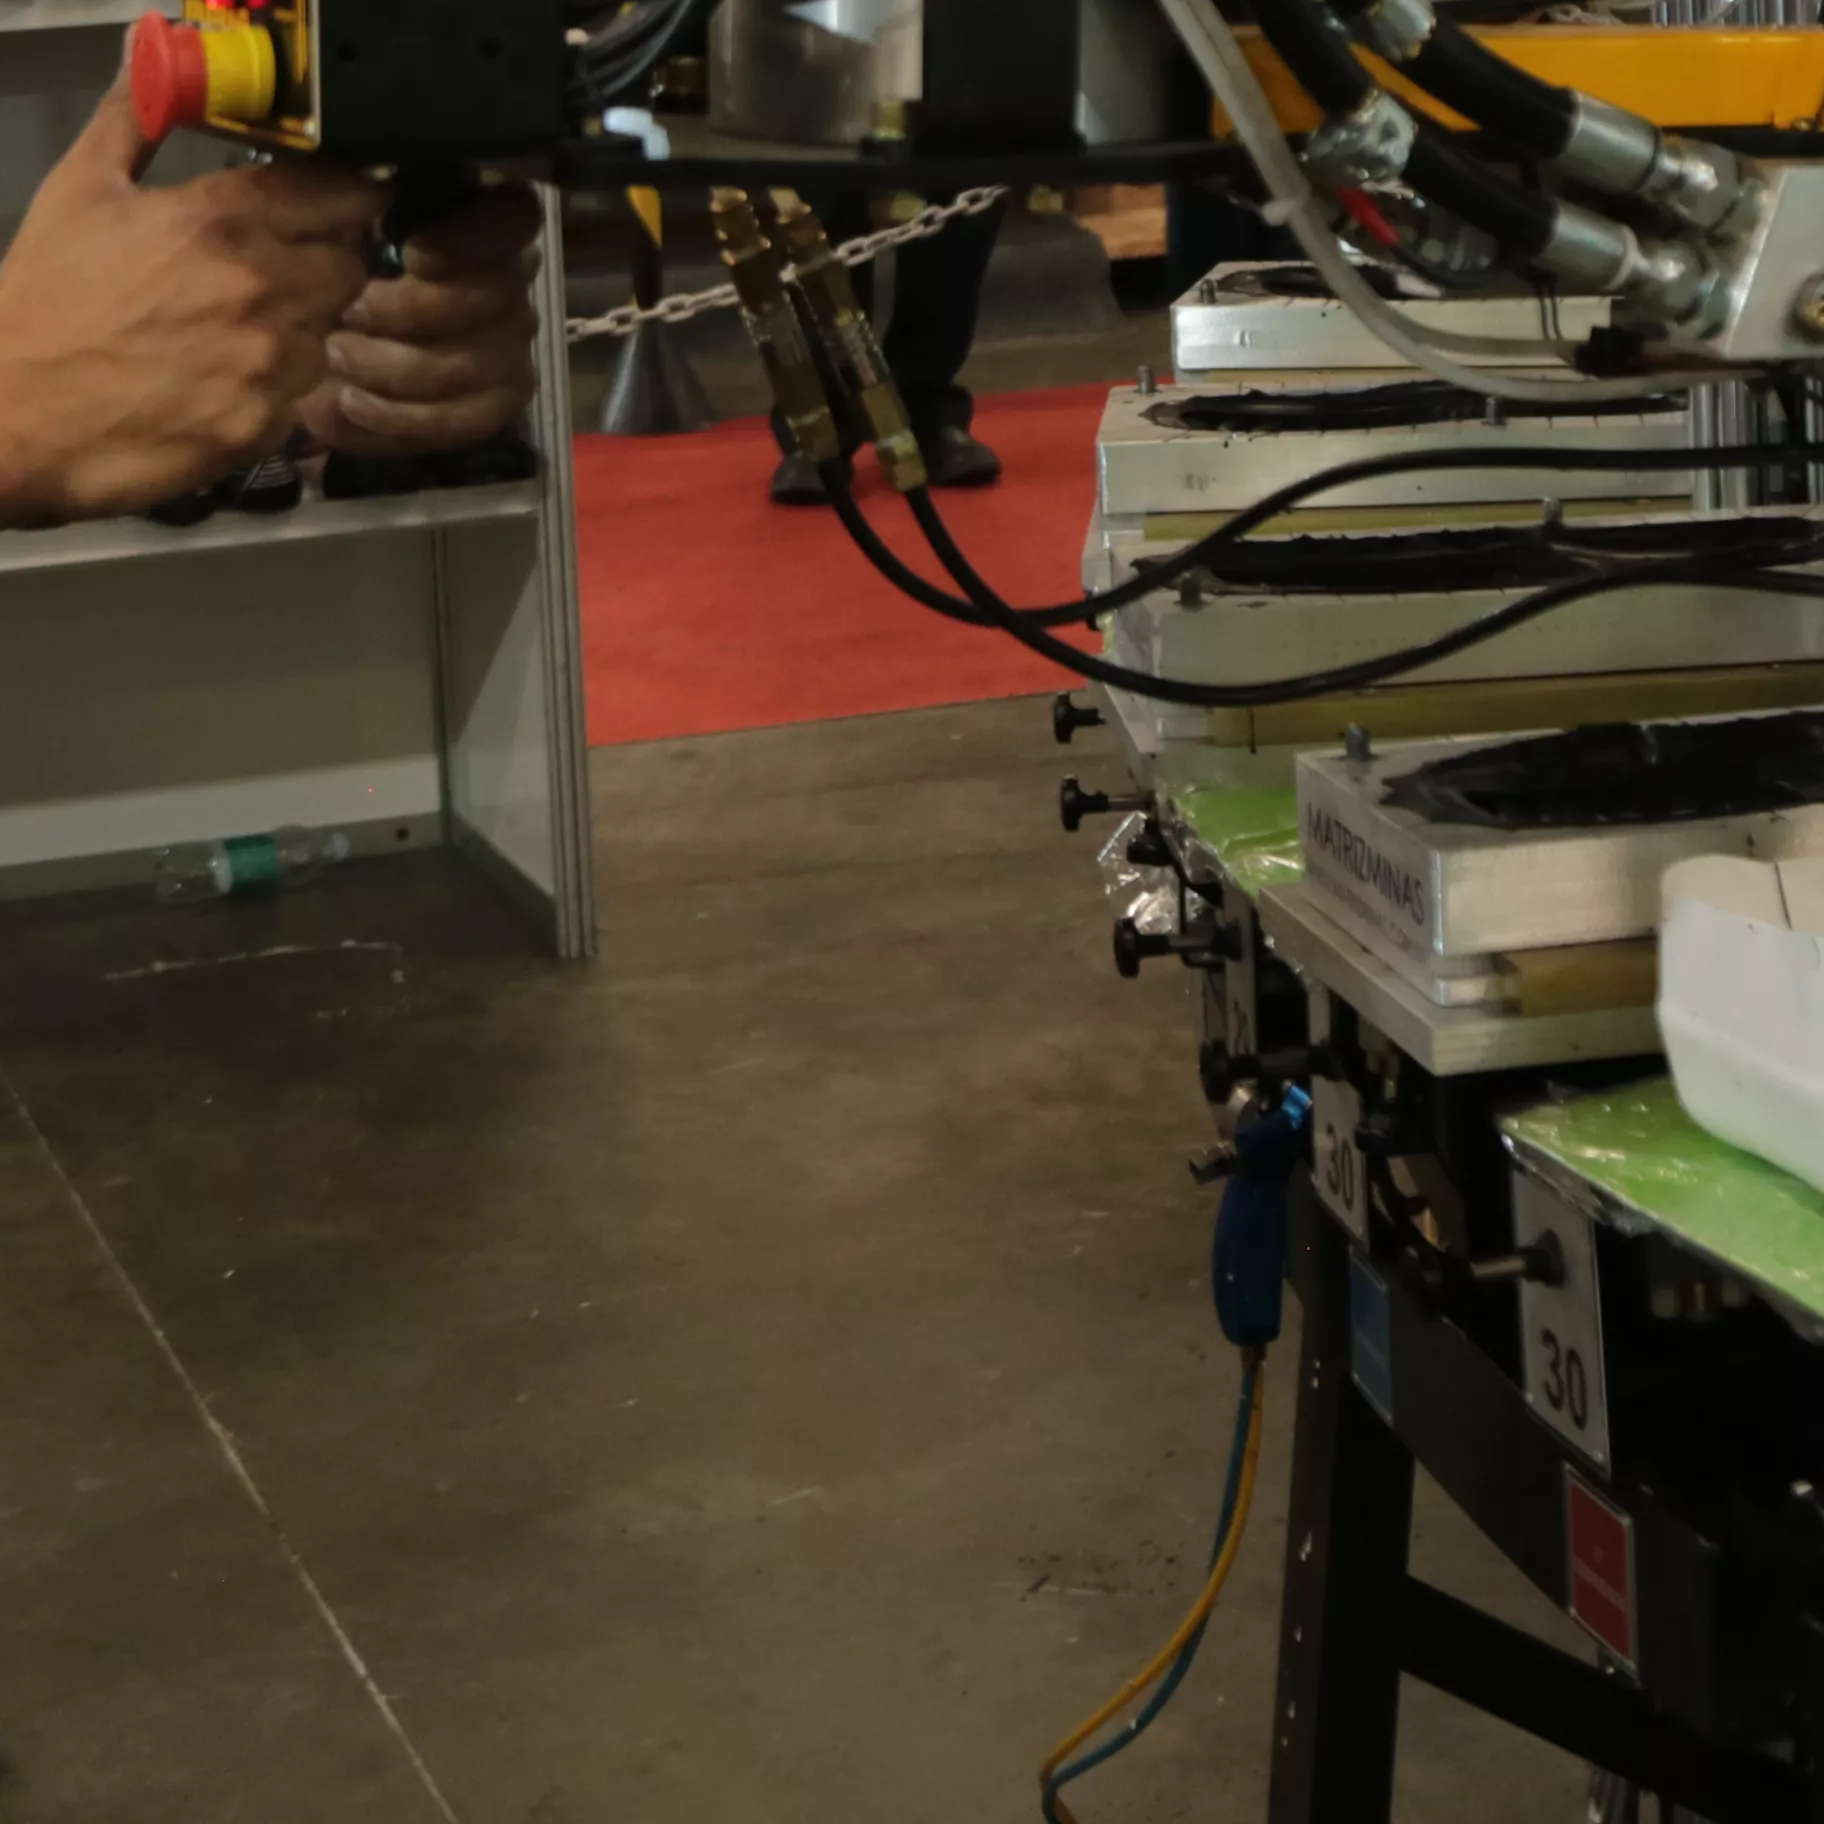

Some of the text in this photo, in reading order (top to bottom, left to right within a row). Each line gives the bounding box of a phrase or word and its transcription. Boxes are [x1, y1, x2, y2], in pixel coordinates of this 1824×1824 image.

[1307, 800, 1426, 927] MATRIZMINAS
[1325, 1121, 1356, 1212] 30
[1540, 1327, 1589, 1431] 30
